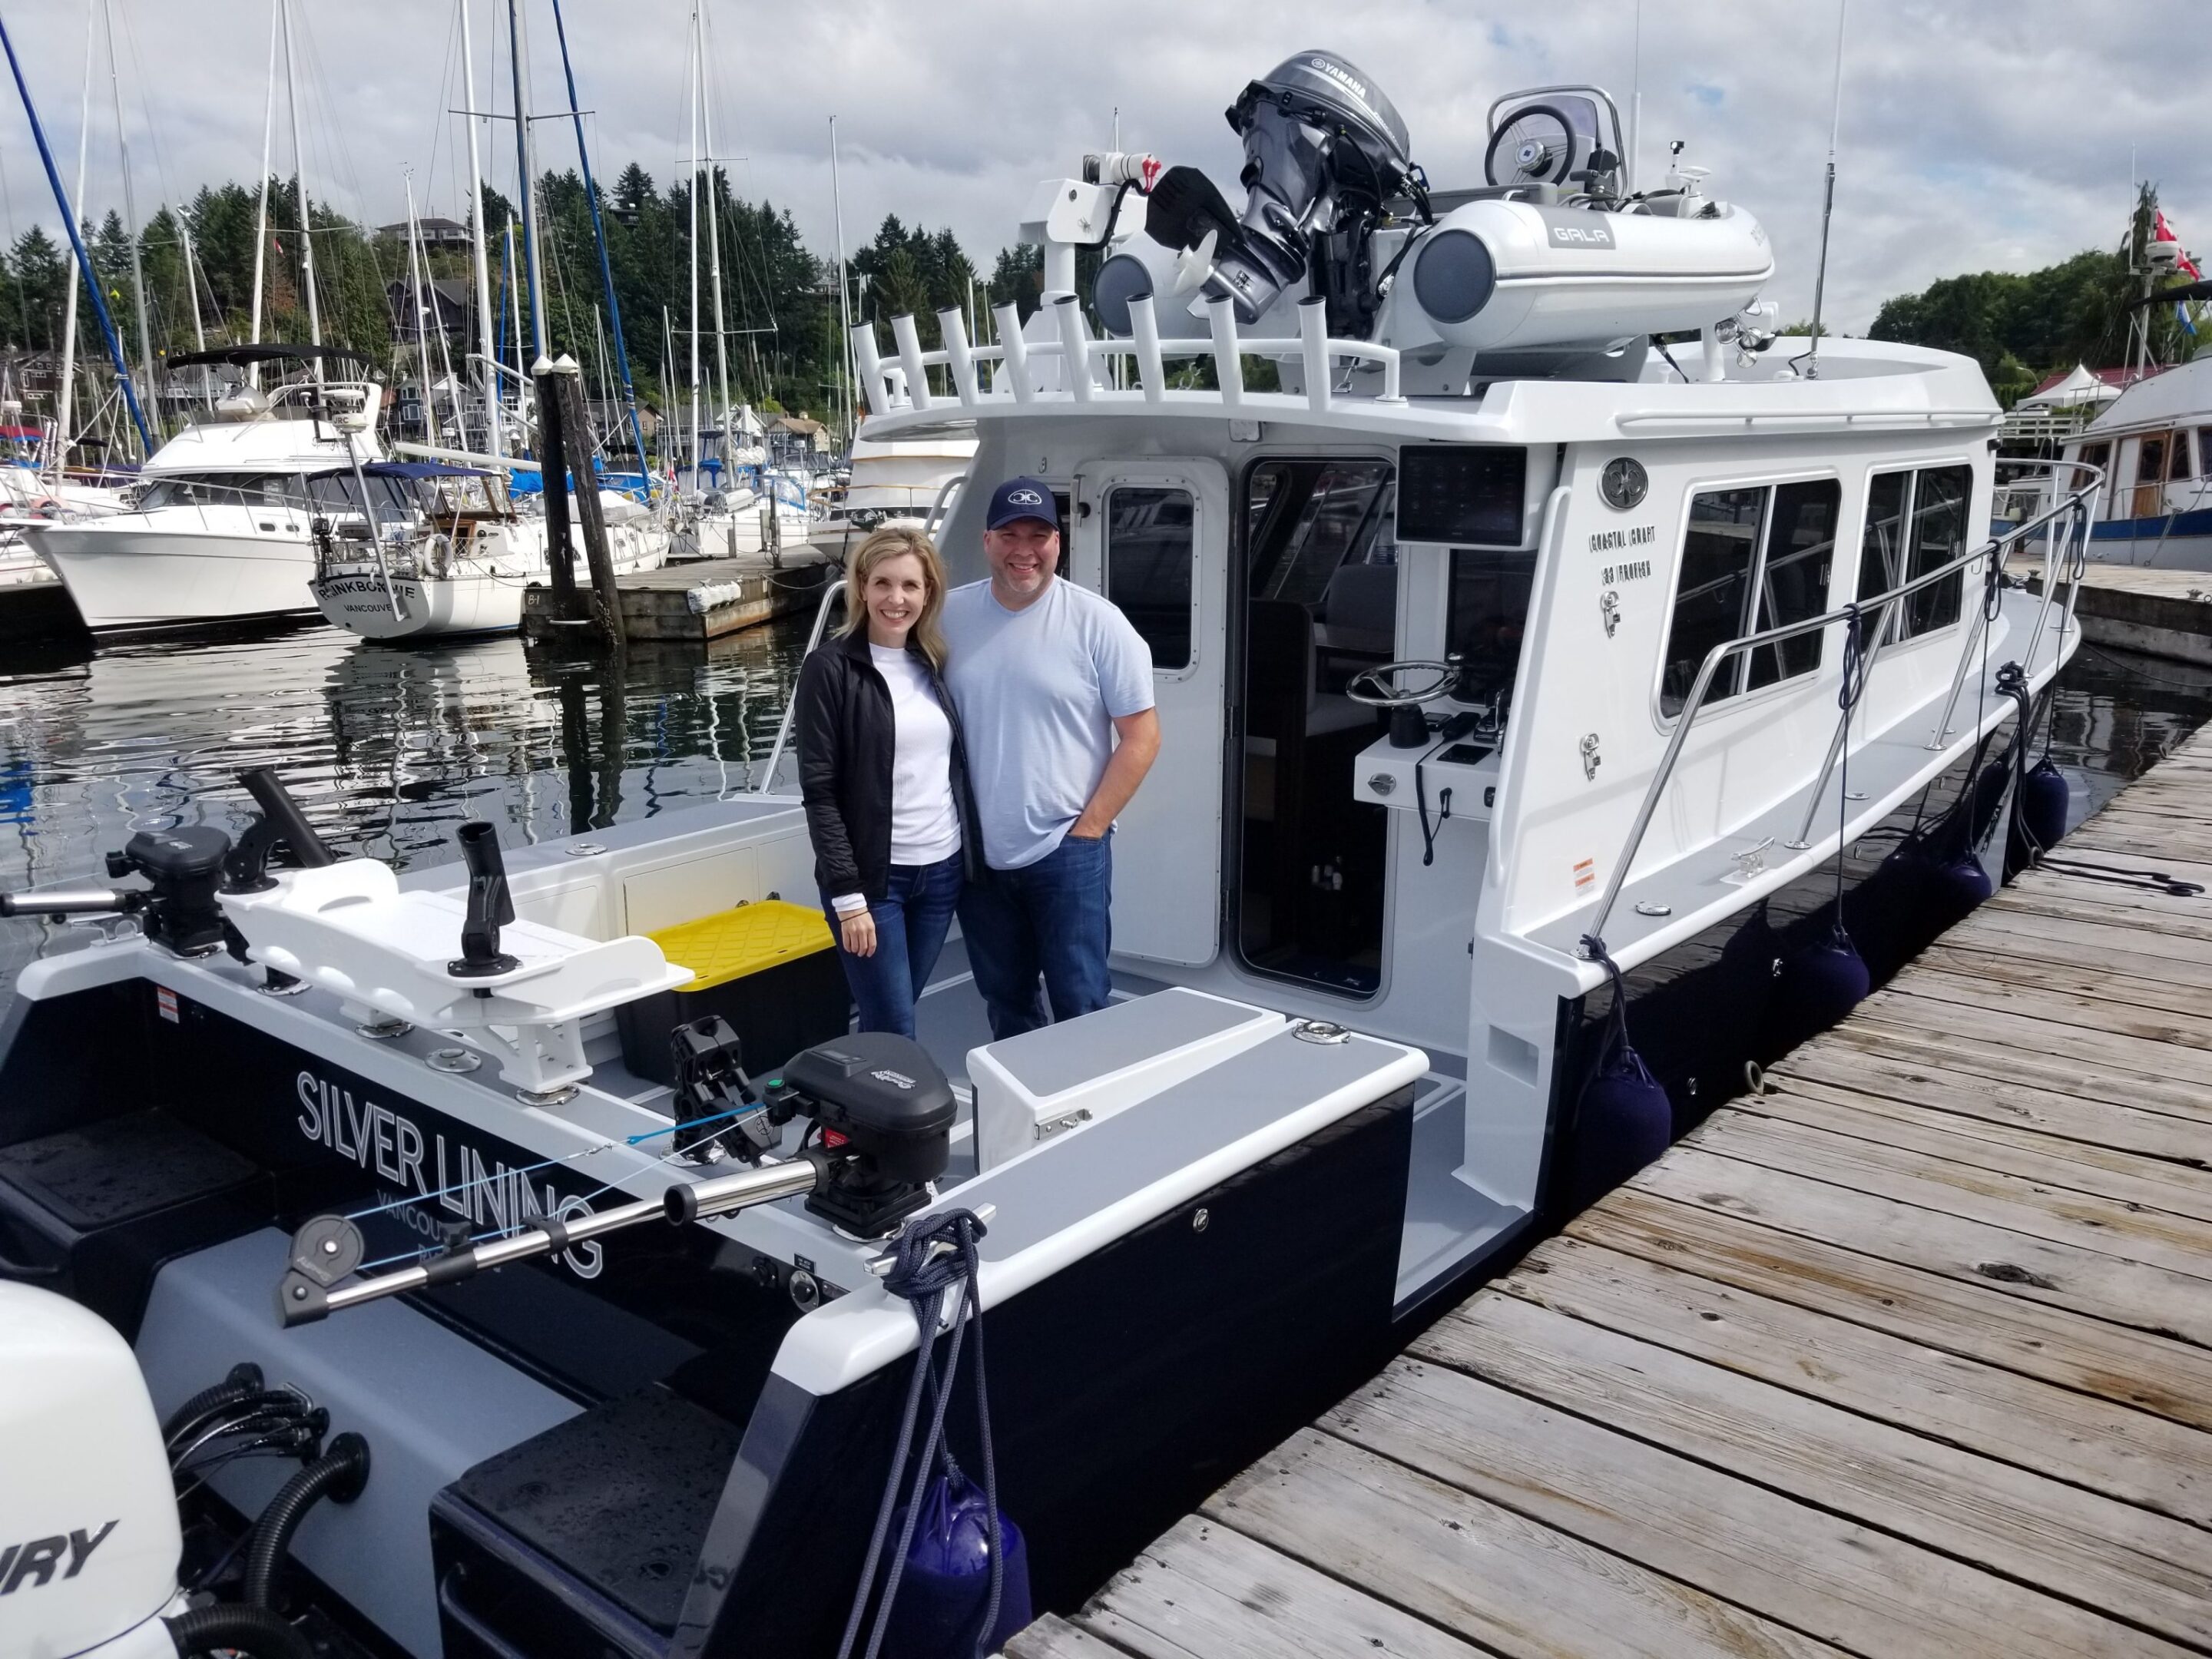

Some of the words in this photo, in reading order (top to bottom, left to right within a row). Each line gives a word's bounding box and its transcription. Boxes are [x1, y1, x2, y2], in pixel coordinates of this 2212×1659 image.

[1325, 62, 1367, 98] YAMAHA
[1553, 227, 1610, 242] GALA
[1589, 530, 1627, 552] COASTAL
[1629, 525, 1655, 546] CRAFT
[343, 603, 393, 613] VANCOUVE
[297, 1070, 428, 1196] SILVER
[376, 1188, 445, 1243] VANCOU
